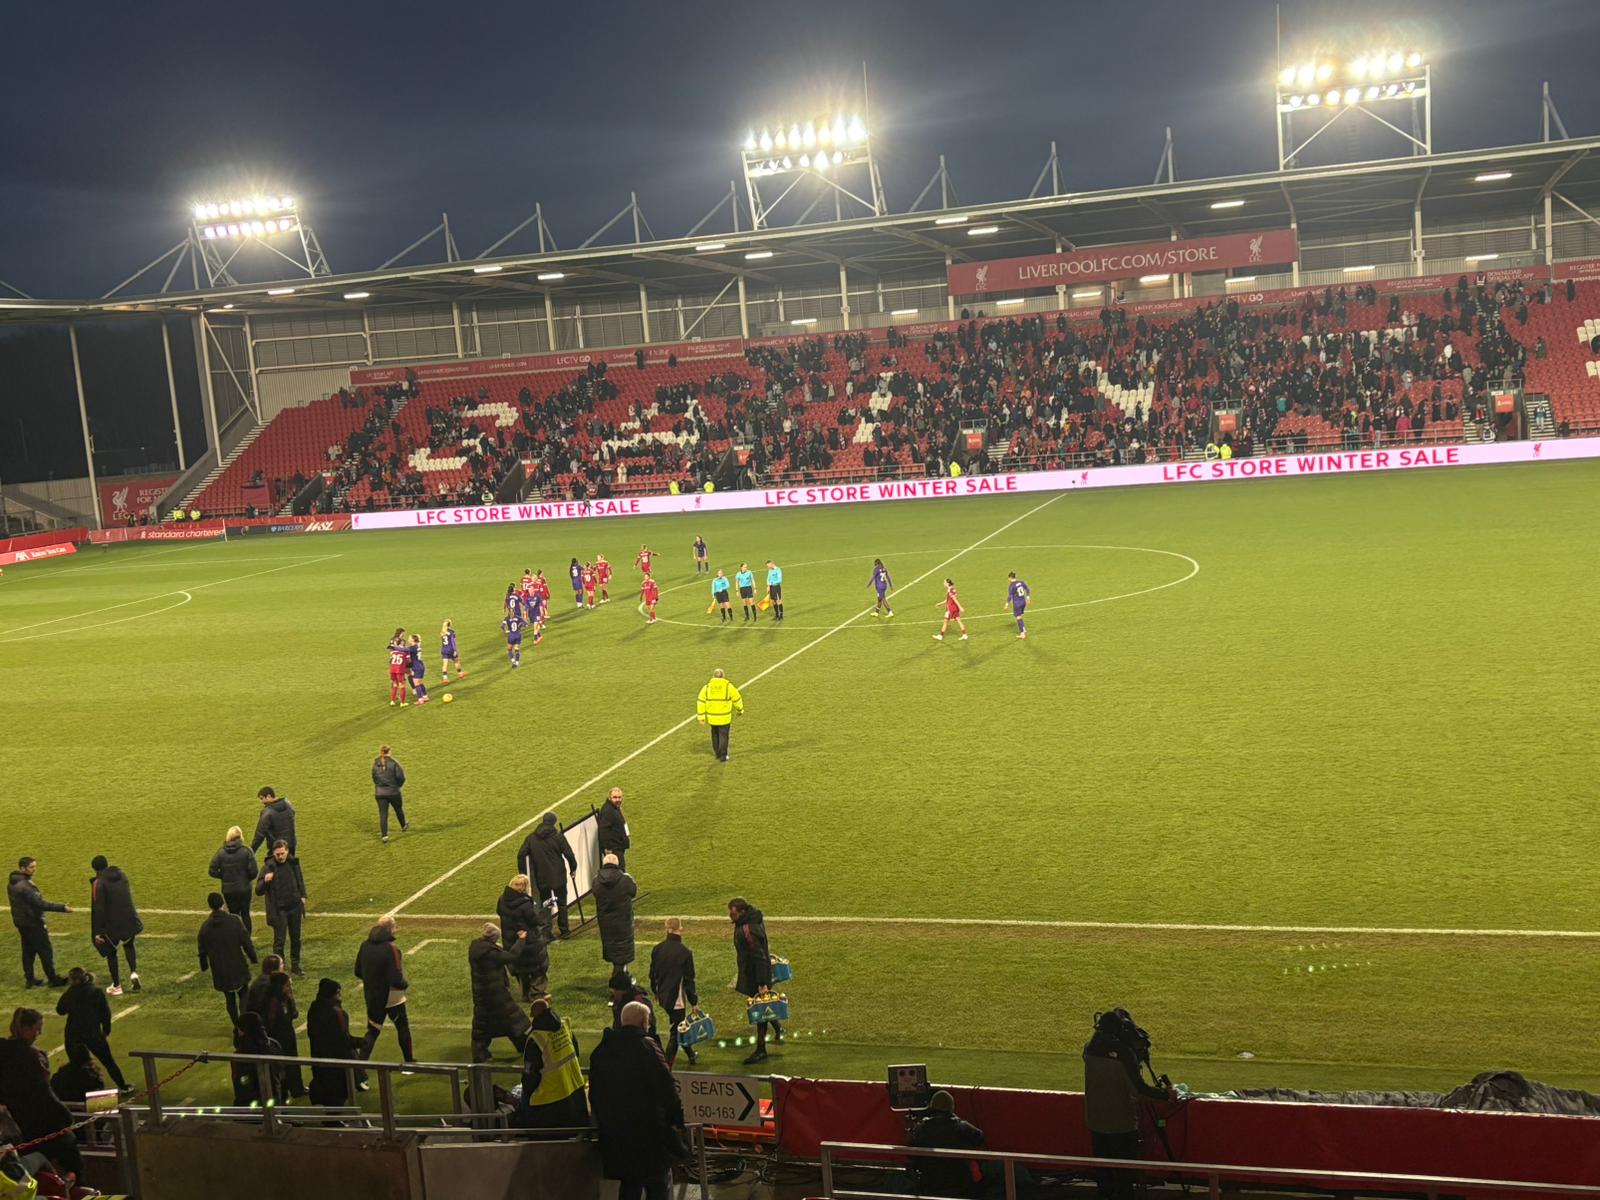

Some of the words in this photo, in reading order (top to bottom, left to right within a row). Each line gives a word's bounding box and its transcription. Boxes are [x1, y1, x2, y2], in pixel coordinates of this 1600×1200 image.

[1018, 246, 1219, 280] LIVERPOOLFC.COM/STORE
[1163, 463, 1203, 481] LFC
[1211, 458, 1288, 478] STORE
[1297, 451, 1390, 472] WINTER
[1399, 447, 1460, 466] SALE
[765, 490, 799, 505] LFC
[805, 485, 871, 503] STORE
[878, 480, 958, 499] WINTER
[965, 476, 1018, 493] SALE
[416, 510, 448, 525] LFC
[453, 506, 512, 523] STORE
[595, 499, 642, 515] SALE
[148, 530, 184, 539] standard
[509, 599, 516, 608] 6
[511, 621, 518, 632] 9
[442, 635, 449, 645] 3
[690, 1080, 735, 1097] SEATS
[692, 1104, 736, 1119] 150-163
